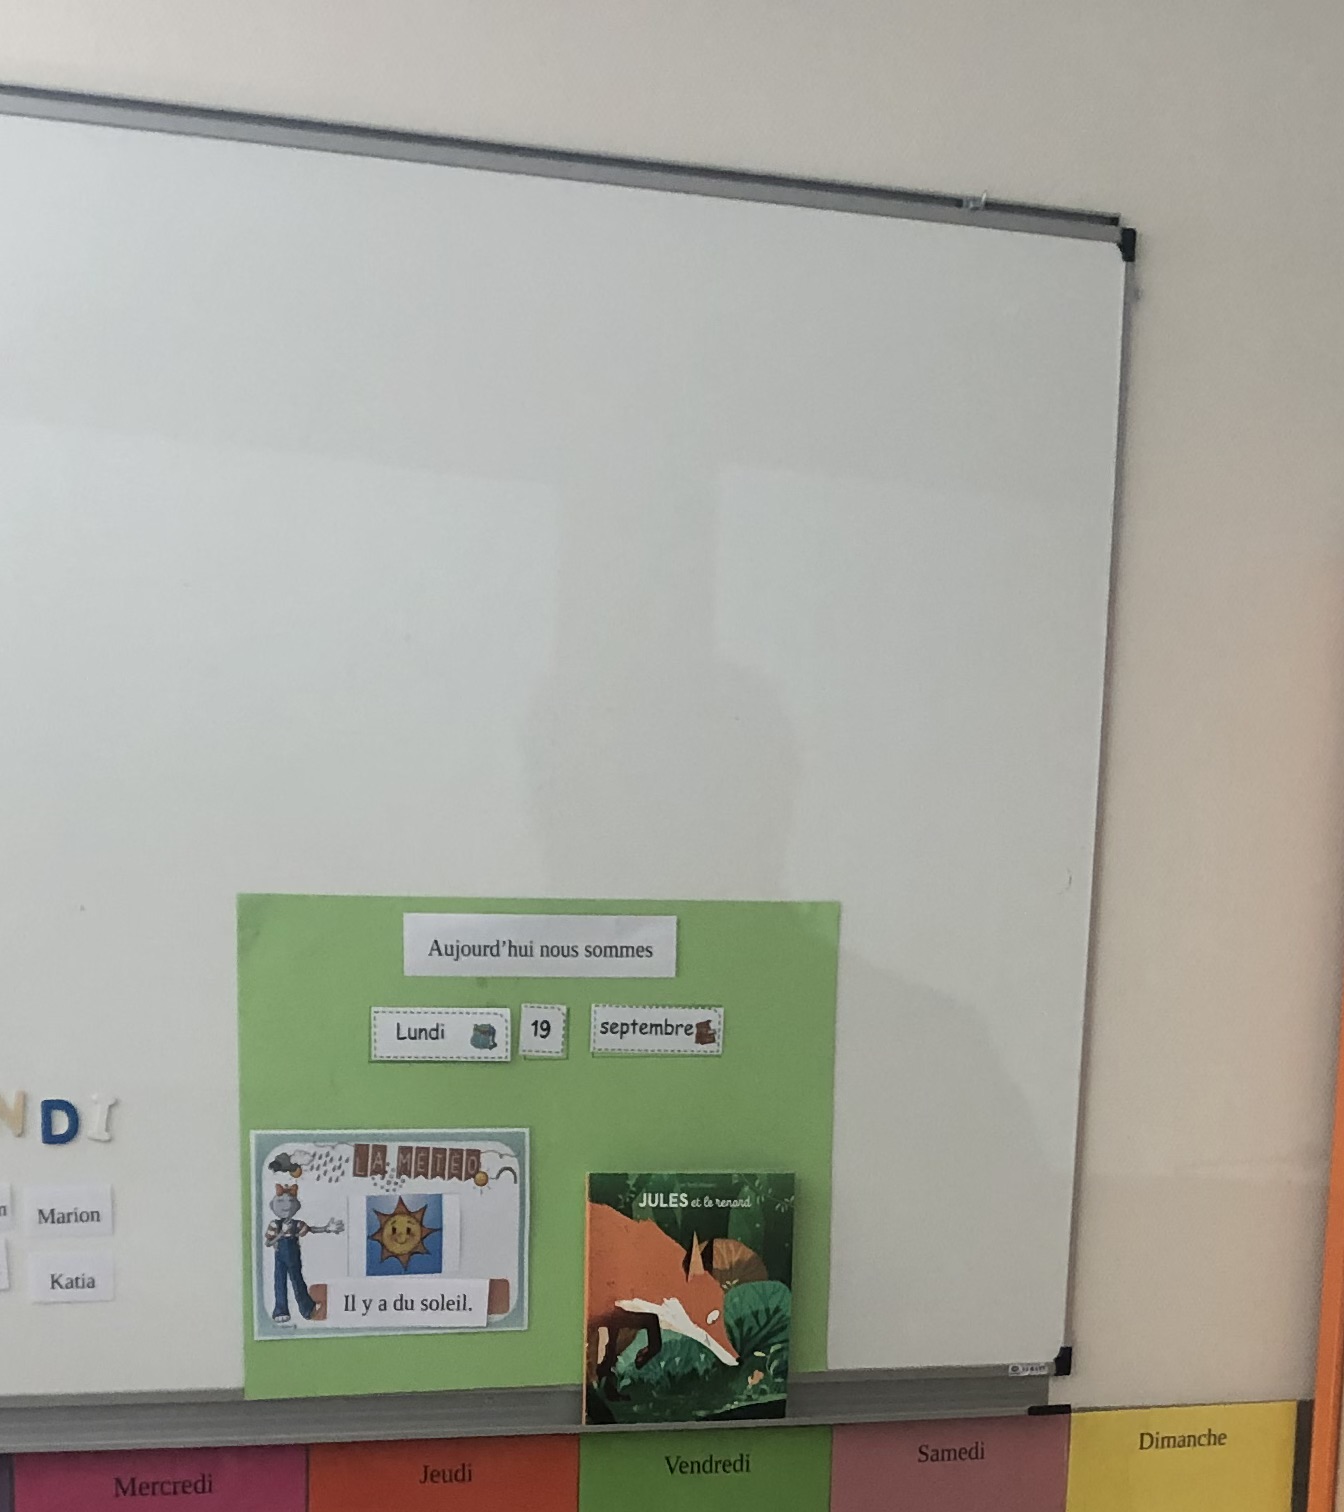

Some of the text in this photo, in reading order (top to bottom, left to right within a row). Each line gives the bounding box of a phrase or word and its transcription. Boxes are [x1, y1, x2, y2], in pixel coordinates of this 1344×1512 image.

[540, 944, 579, 958] nous
[584, 944, 654, 959] sommes
[396, 1022, 445, 1041] Lundi
[531, 1019, 552, 1039] 19
[599, 1018, 694, 1044] septembre
[356, 1151, 385, 1175] LA
[638, 1192, 753, 1208] JULES et le renard
[37, 1208, 101, 1225] Marion
[49, 1272, 96, 1291] Katia
[343, 1293, 473, 1317] Il y a du soleil.
[1138, 1428, 1228, 1453] Dimanche
[917, 1440, 986, 1465] Samedi
[418, 1463, 474, 1486] Jeudi
[664, 1453, 751, 1477] Vendredi
[113, 1473, 215, 1498] Mercredi
